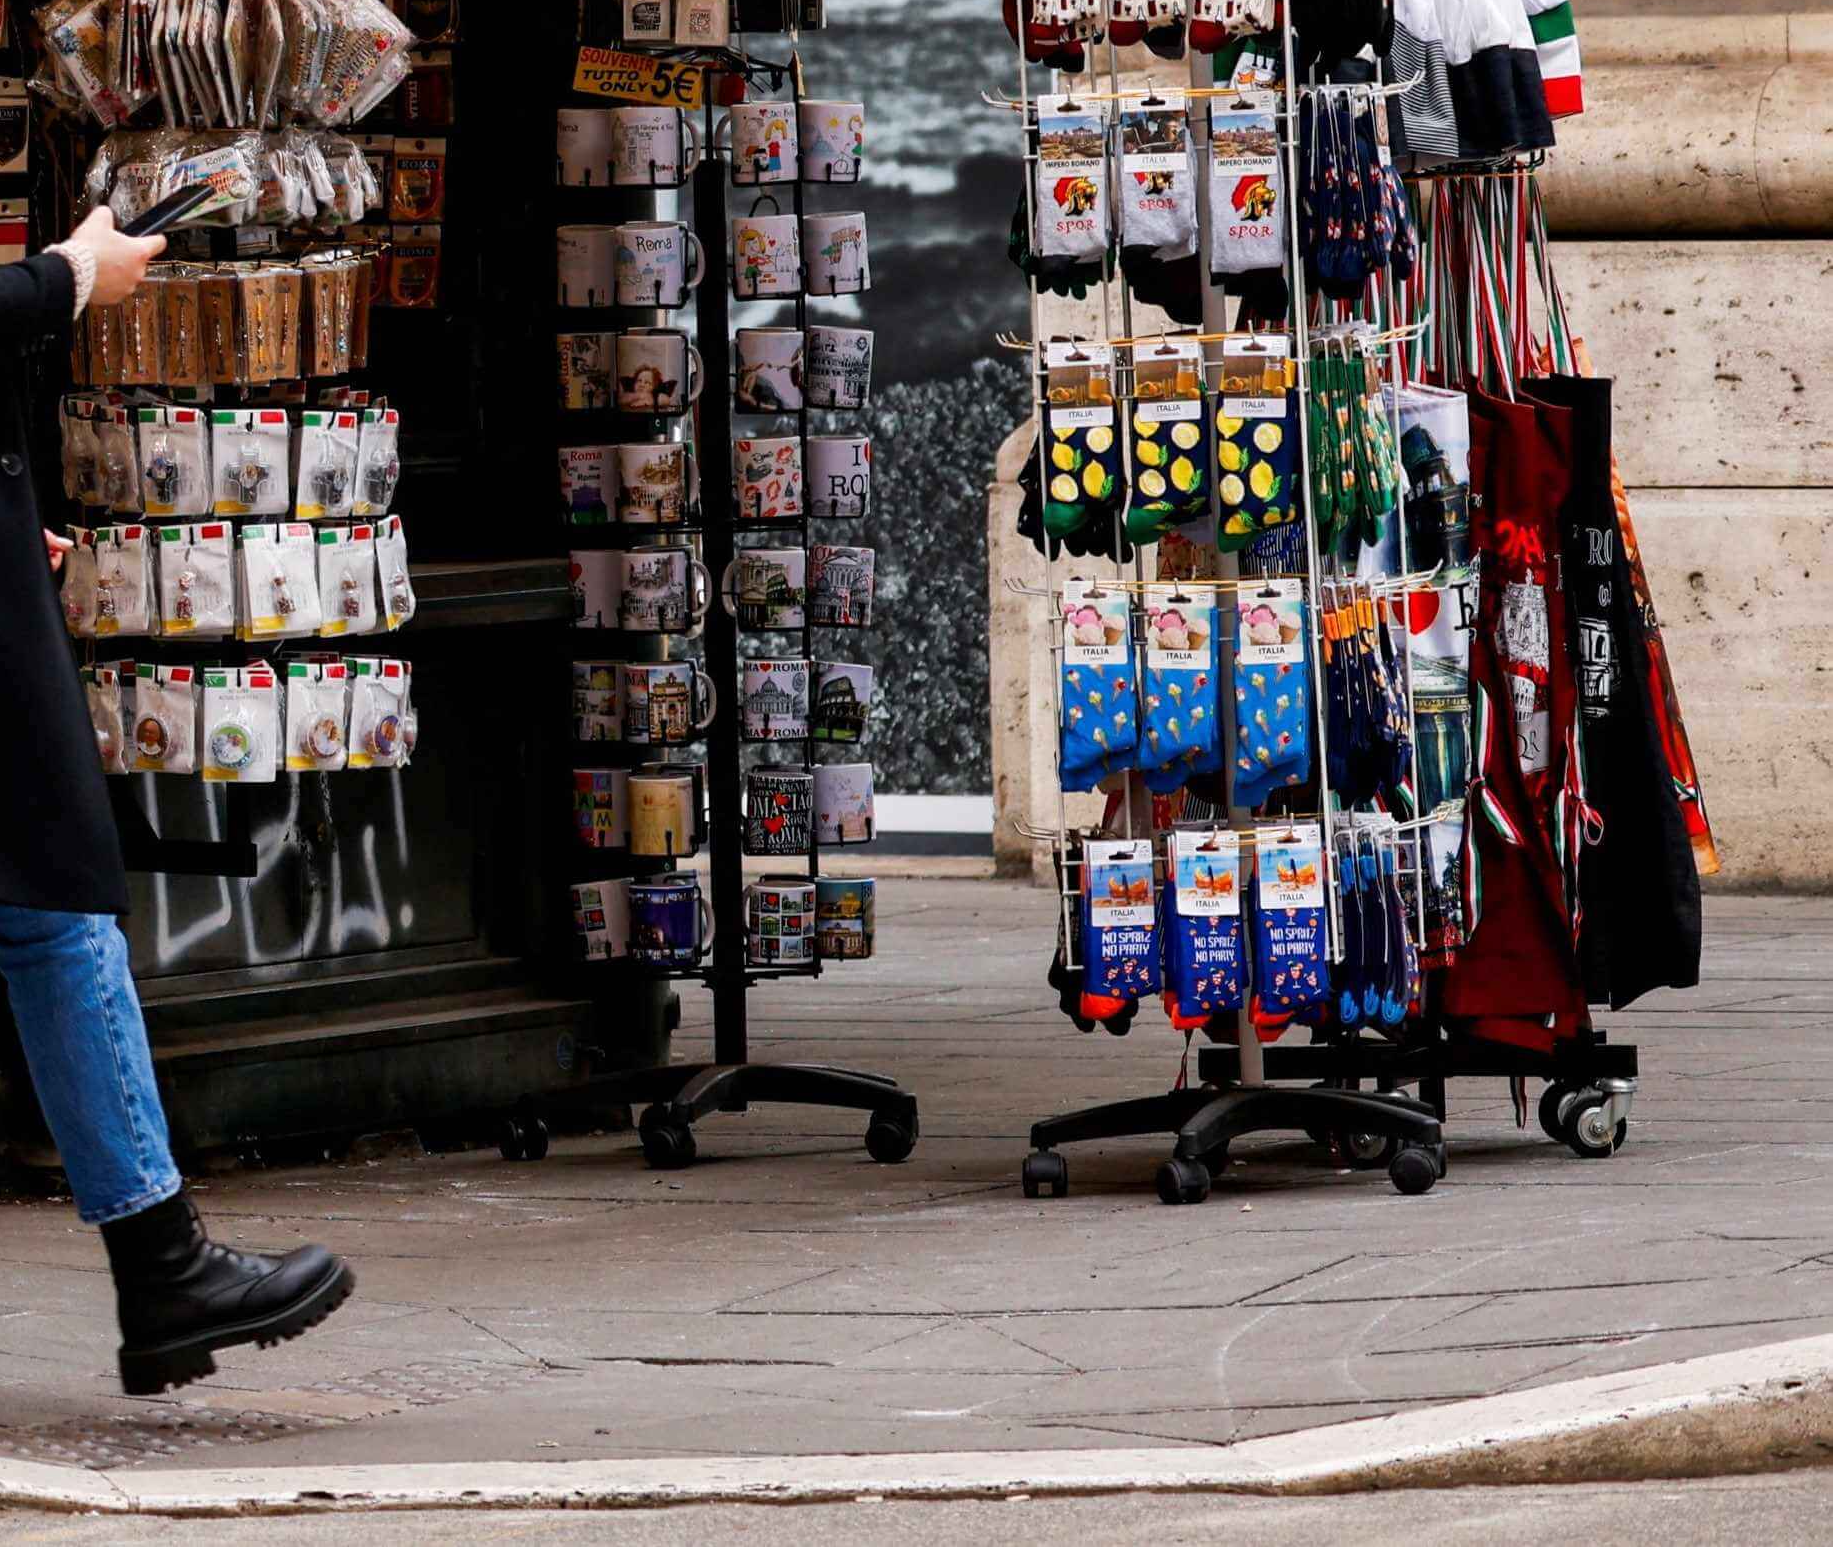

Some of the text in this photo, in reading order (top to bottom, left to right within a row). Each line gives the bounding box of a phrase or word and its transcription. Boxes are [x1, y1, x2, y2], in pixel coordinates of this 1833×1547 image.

[581, 47, 654, 73] SOUVENIR
[582, 68, 639, 85] TUTTO
[600, 79, 648, 94] ONLY
[1045, 157, 1100, 169] IMPERO ROMANO
[1217, 157, 1272, 167] IMPERO ROMANO
[636, 235, 673, 253] Roma
[1156, 404, 1182, 414] ITALIA
[1240, 400, 1266, 410] ITALIA
[1069, 408, 1096, 420] ITALIA
[1081, 646, 1110, 657] ITALIA
[1165, 651, 1193, 662] ITALIA
[1257, 646, 1286, 656] ITALIA
[773, 661, 807, 673] ROMA
[774, 727, 808, 738] ROMA
[1278, 892, 1305, 903] ITALIA
[1194, 899, 1221, 910] ITALIA
[1109, 909, 1136, 919] ITALIA
[1118, 931, 1152, 944] SPRITZ
[1118, 943, 1150, 956] PARTY
[1286, 942, 1316, 956] PARTY
